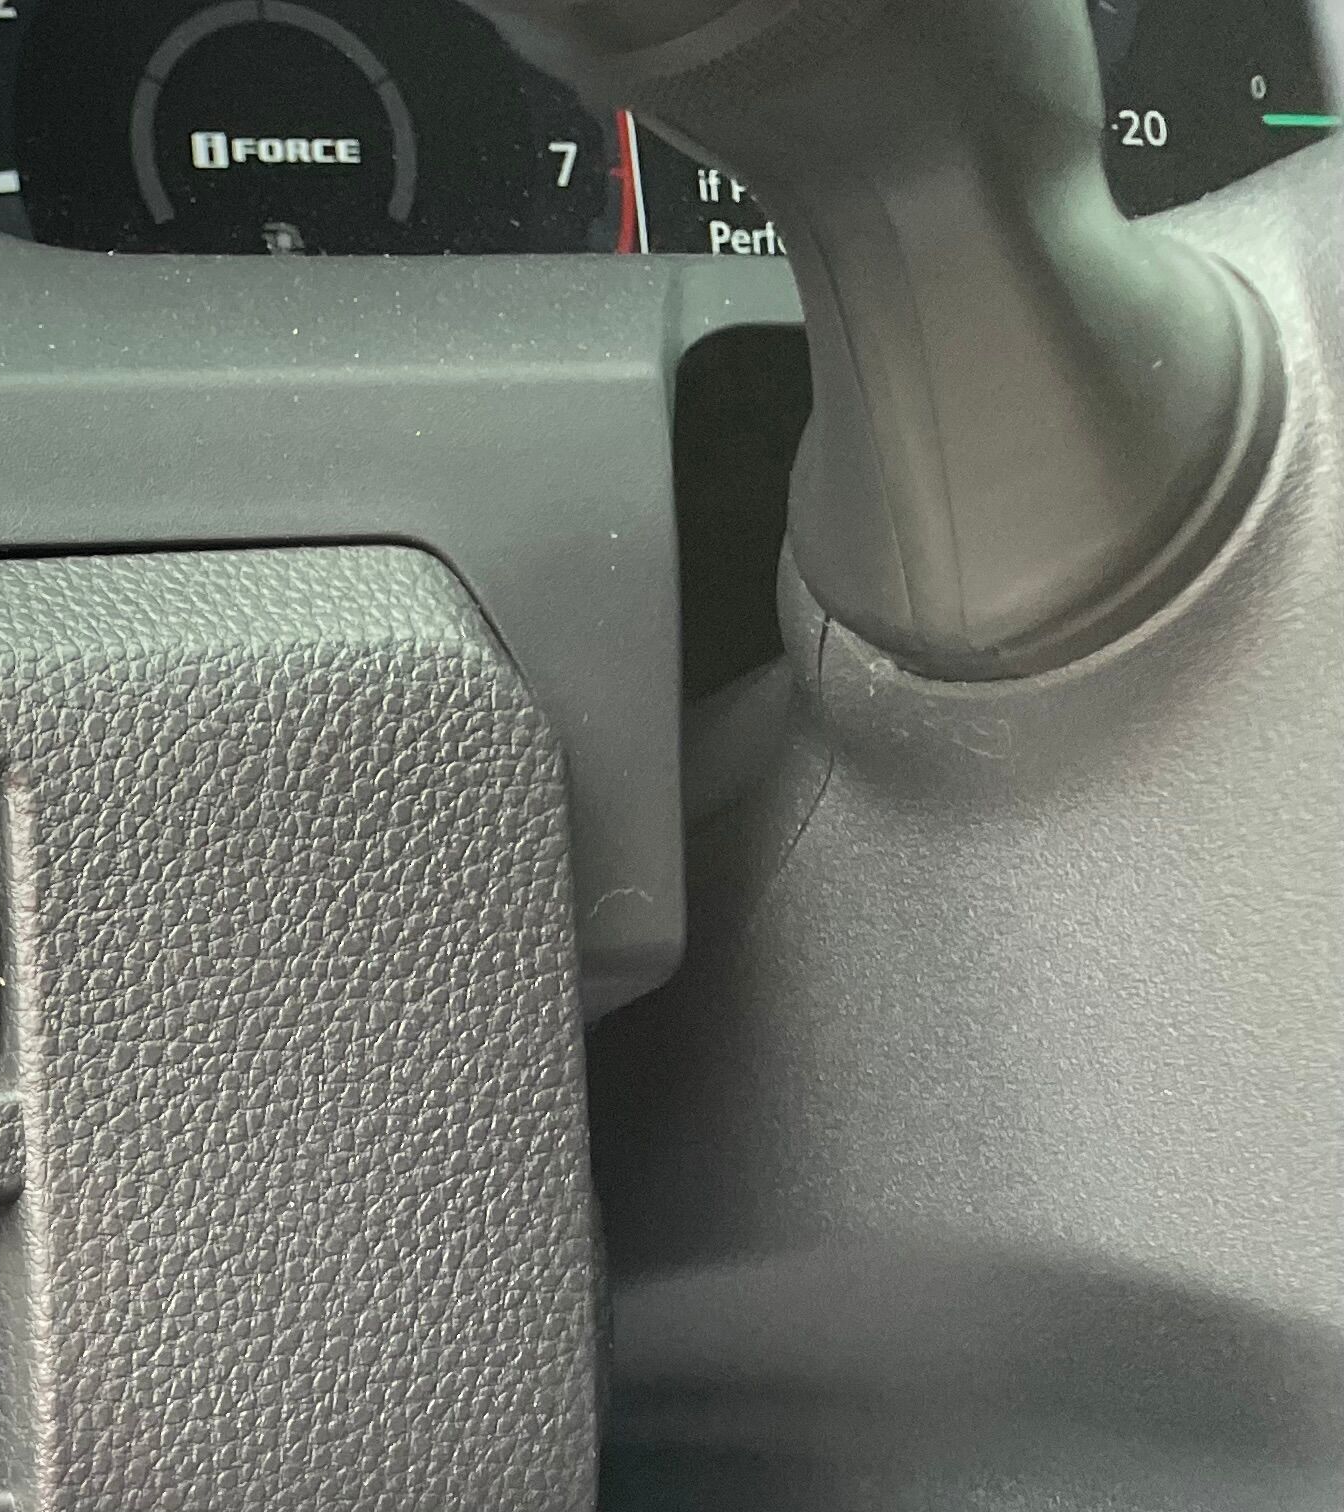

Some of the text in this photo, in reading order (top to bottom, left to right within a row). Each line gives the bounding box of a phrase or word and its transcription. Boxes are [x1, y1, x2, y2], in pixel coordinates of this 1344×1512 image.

[1118, 109, 1168, 147] 20
[547, 141, 578, 188] 7
[697, 169, 721, 203] if
